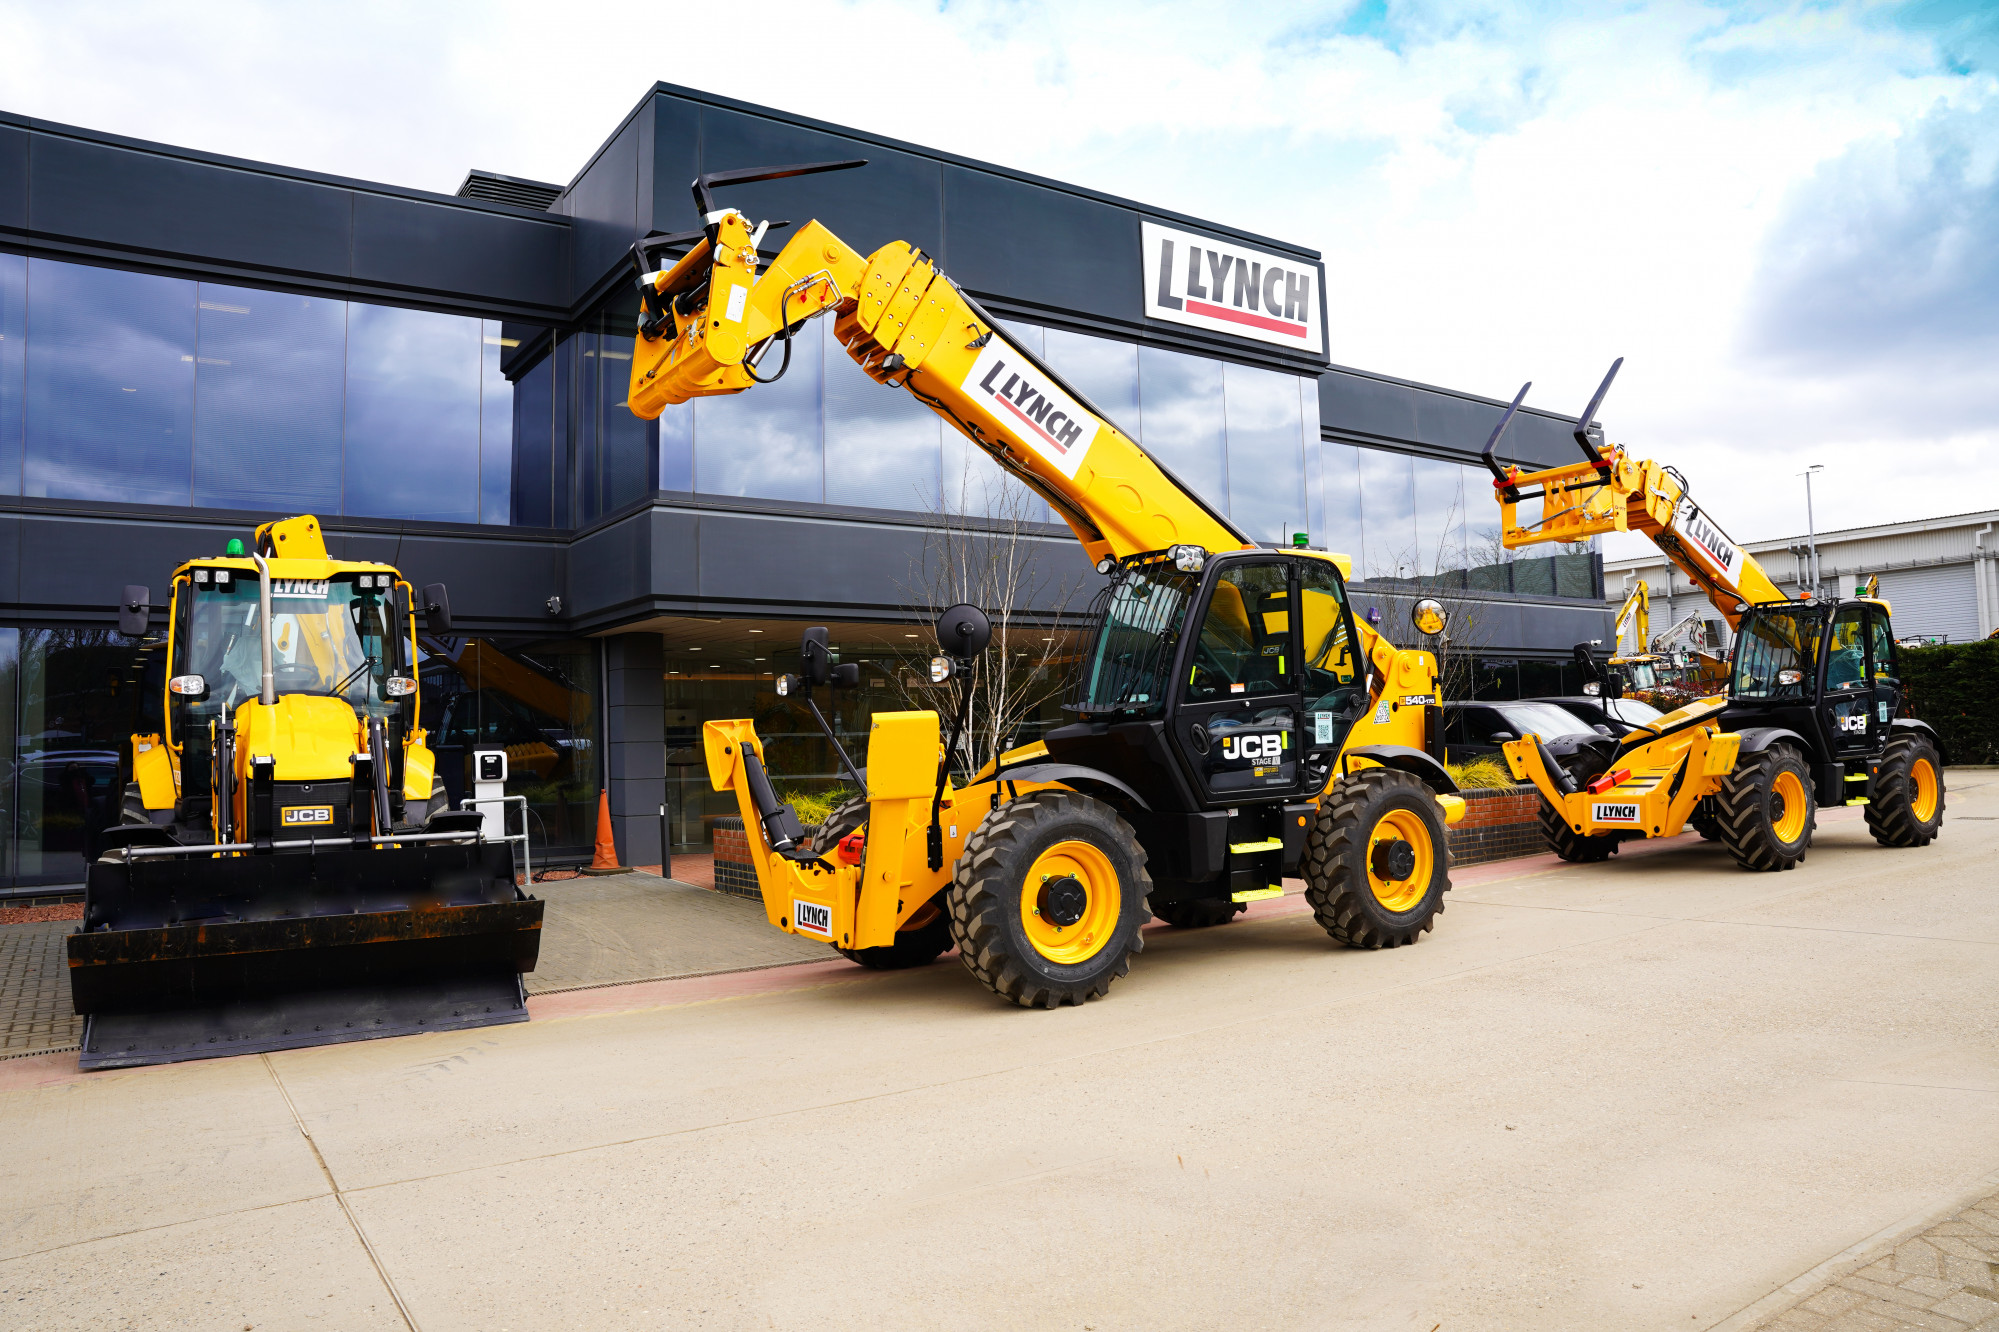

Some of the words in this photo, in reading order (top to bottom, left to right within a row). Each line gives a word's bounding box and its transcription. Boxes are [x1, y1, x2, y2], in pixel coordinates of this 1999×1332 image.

[271, 579, 329, 594] LYNCH
[1841, 716, 1866, 731] JCB
[1223, 735, 1282, 759] JCB
[1252, 758, 1271, 766] STAGE
[286, 809, 329, 822] JCB
